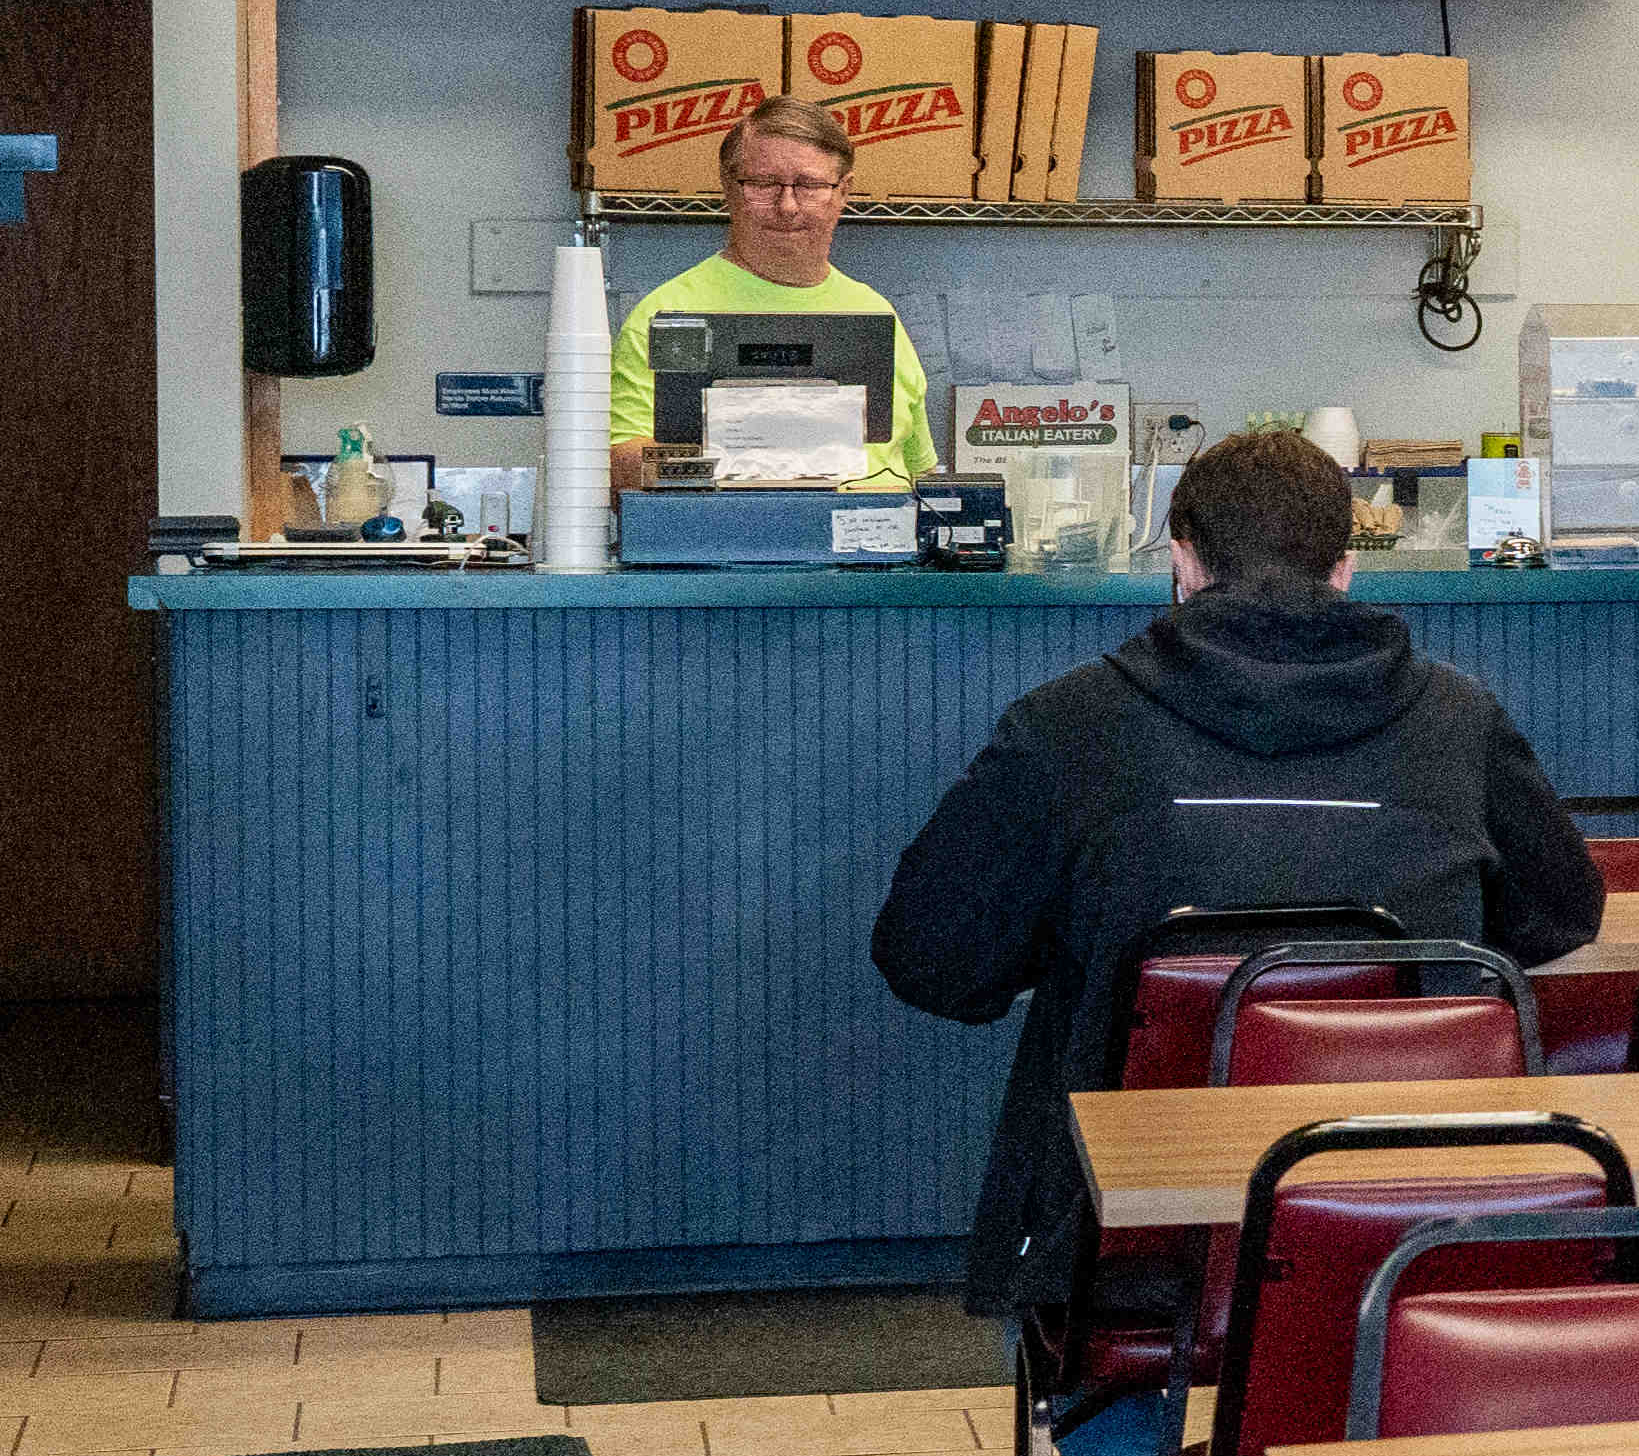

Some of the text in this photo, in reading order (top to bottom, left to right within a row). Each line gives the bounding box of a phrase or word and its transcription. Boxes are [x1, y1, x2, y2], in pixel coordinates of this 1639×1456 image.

[828, 86, 965, 139] IZZA
[1178, 106, 1295, 155] PIZZA
[1344, 109, 1458, 156] PIZZA
[971, 399, 1116, 430] Angelo's
[982, 428, 1103, 442] ITALIAN EATERY
